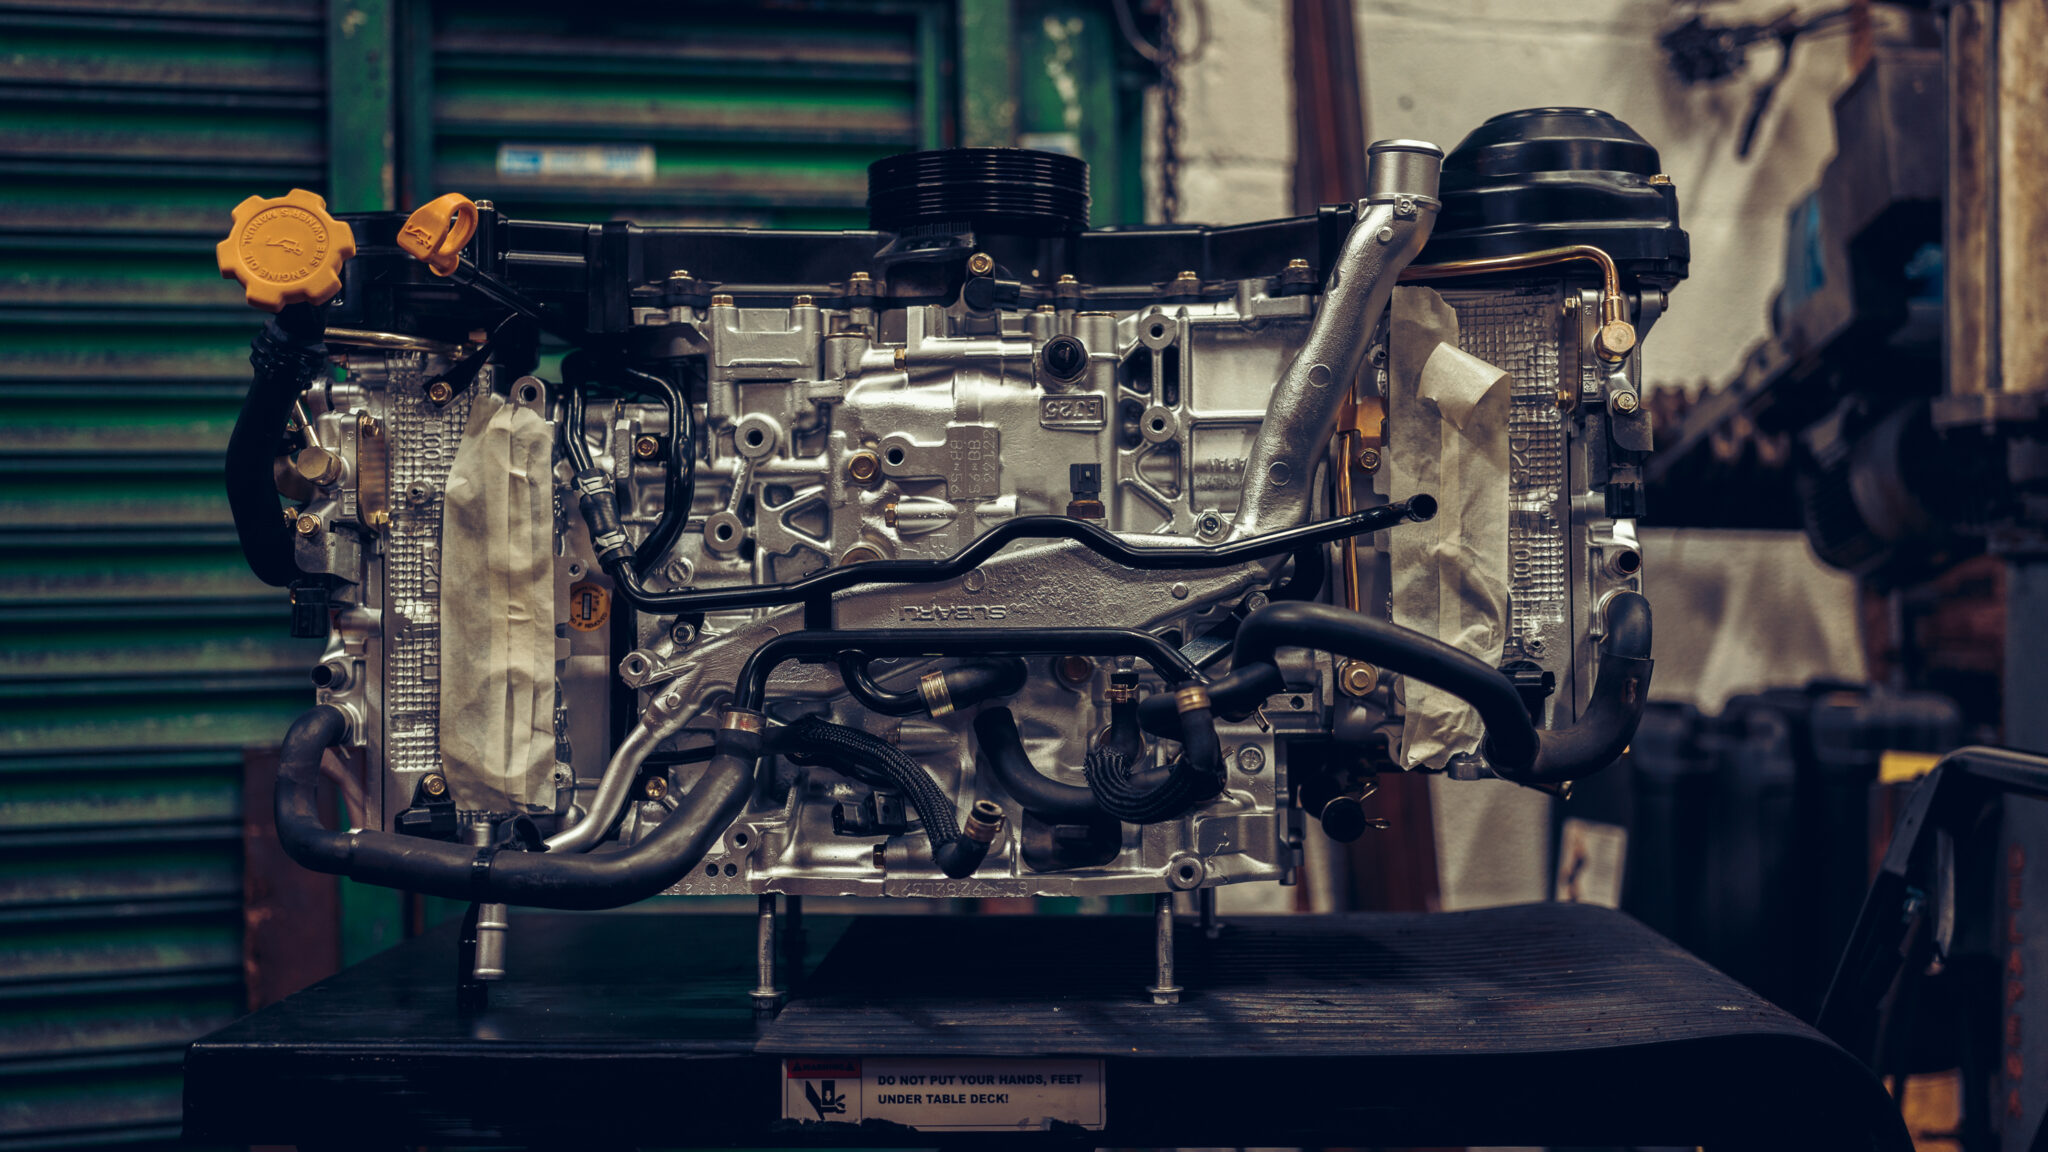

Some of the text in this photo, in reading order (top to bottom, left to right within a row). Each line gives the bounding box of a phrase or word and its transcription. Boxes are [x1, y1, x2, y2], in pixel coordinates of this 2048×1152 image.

[259, 268, 310, 282] ENGINE
[1045, 400, 1099, 418] EJ25
[899, 605, 1007, 621] SUBARU
[878, 1074, 1083, 1086] DO NOT PUT YOUR HANDS, FEET
[878, 1094, 1009, 1104] UNDER TABLE DECK!
